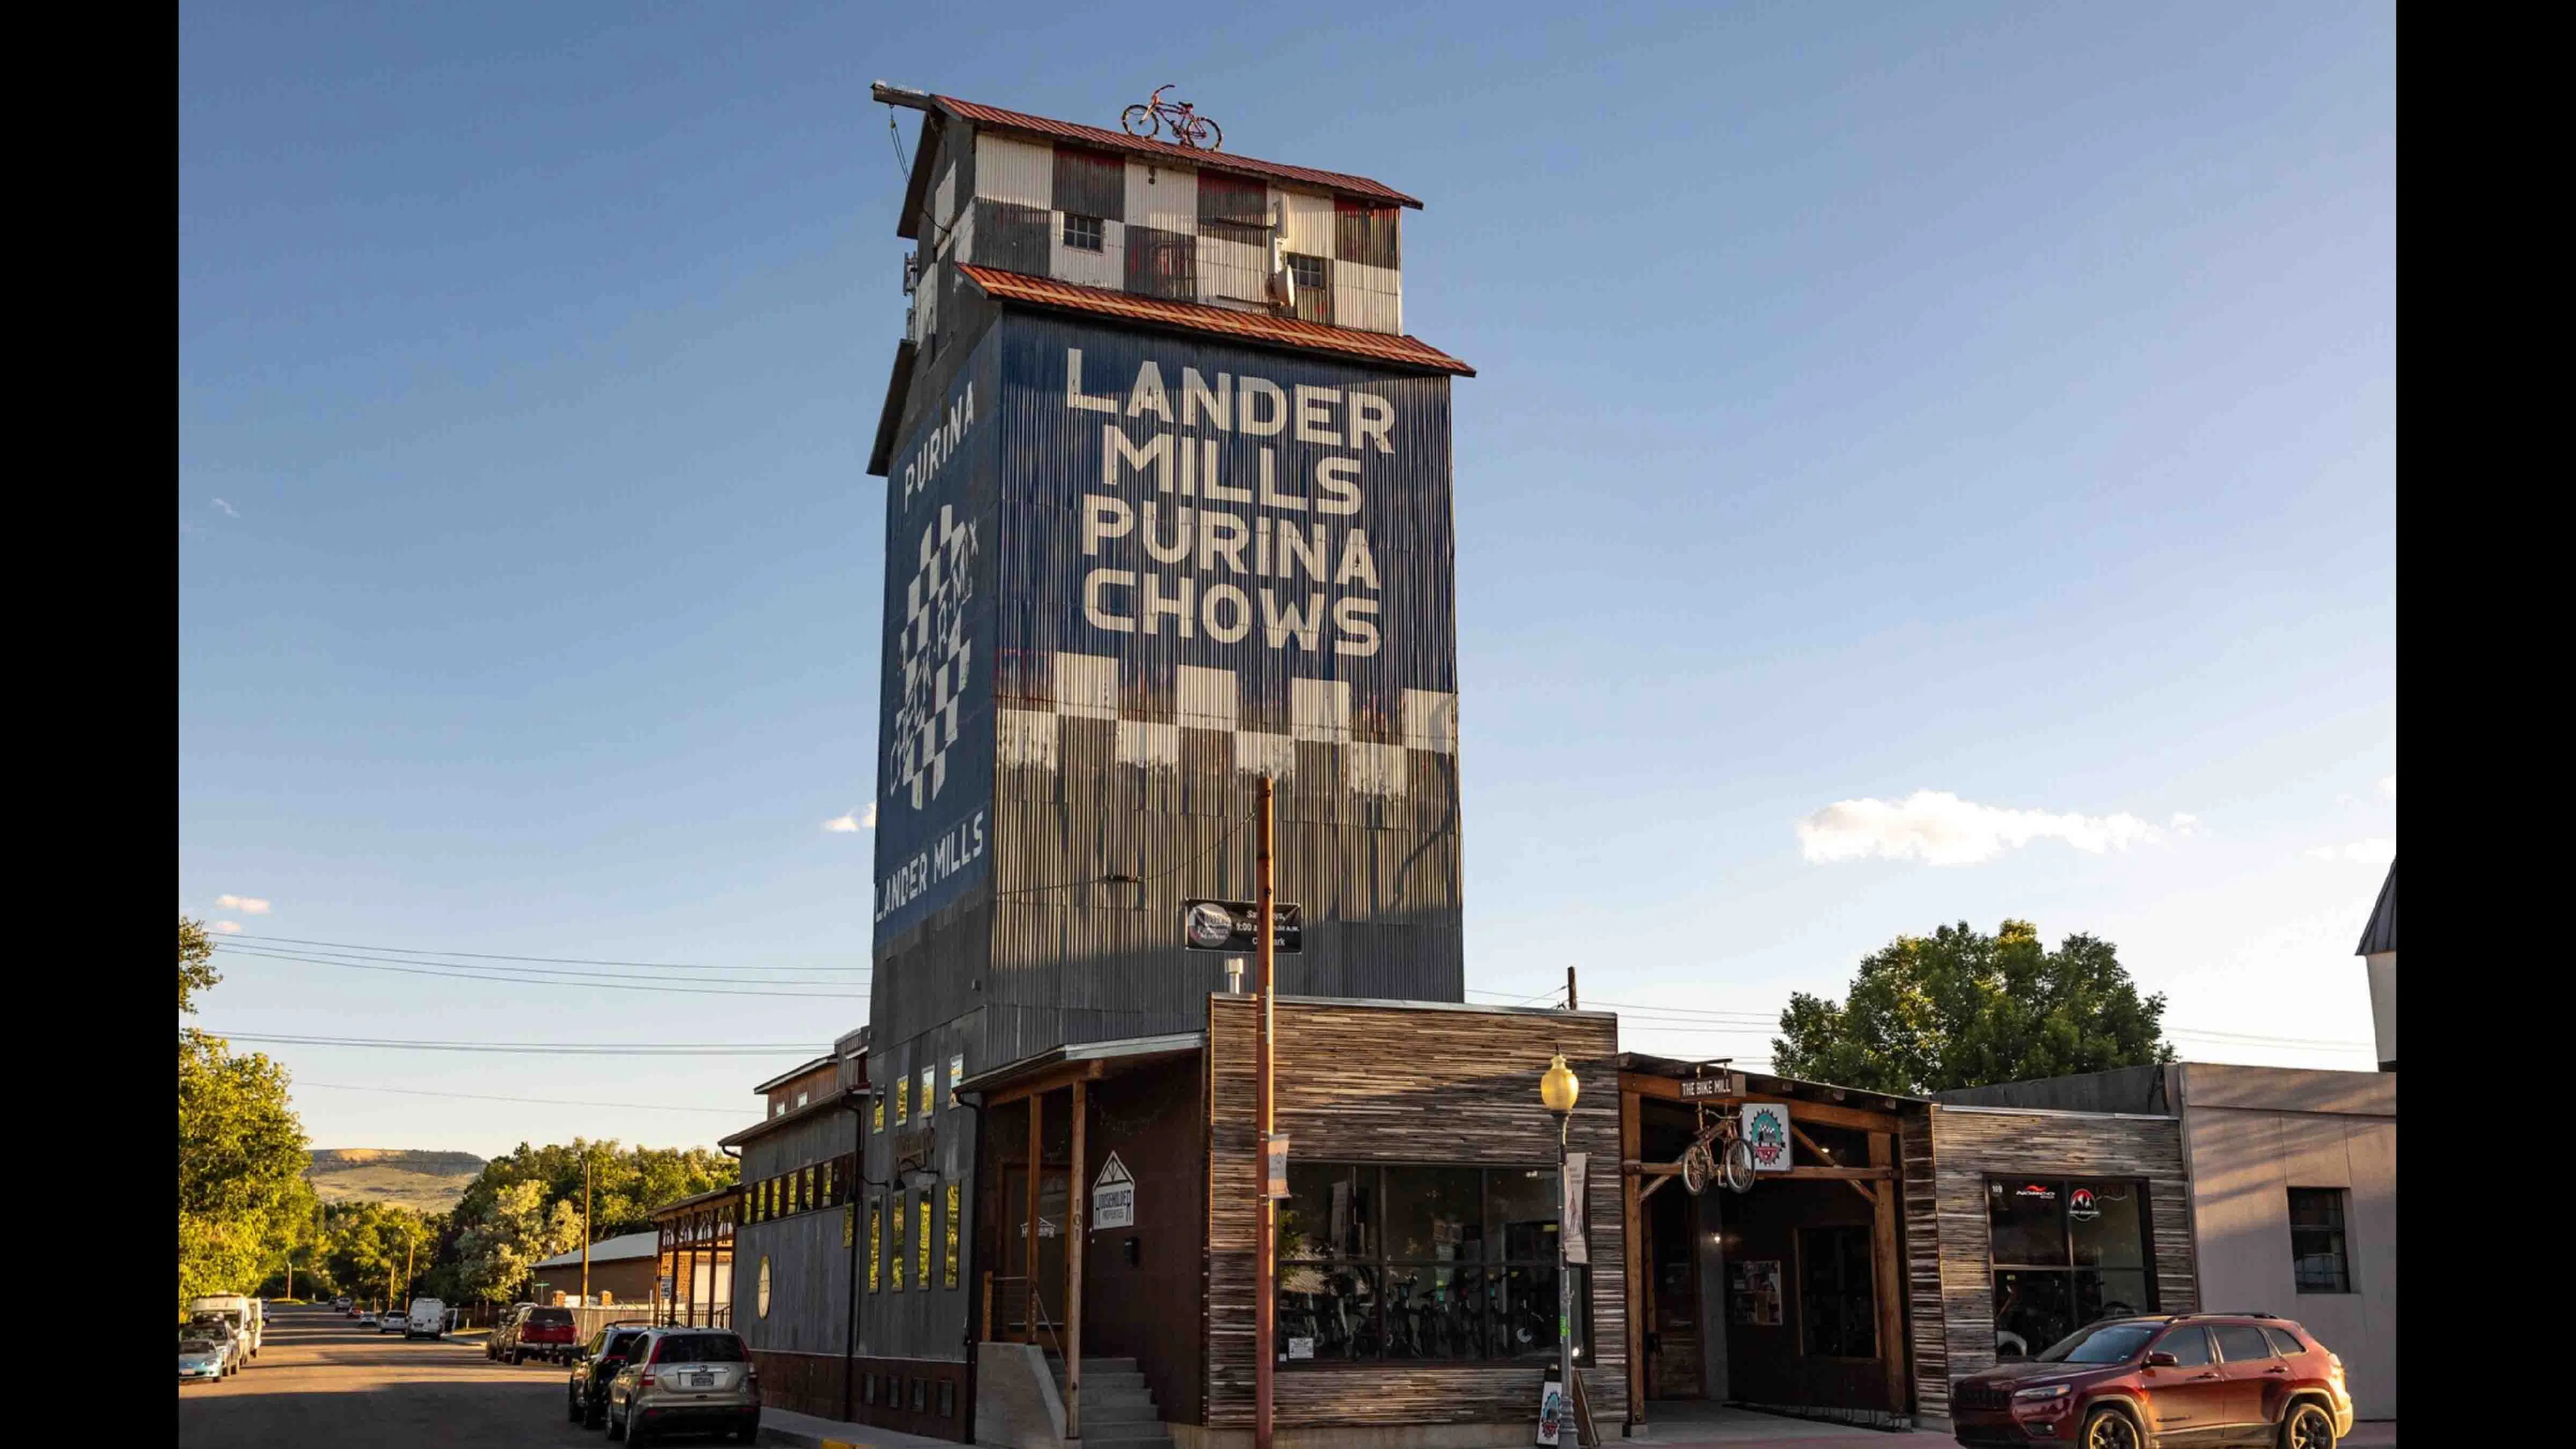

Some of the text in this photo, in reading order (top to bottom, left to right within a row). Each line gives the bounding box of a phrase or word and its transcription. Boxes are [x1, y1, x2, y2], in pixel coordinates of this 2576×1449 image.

[904, 380, 975, 514] PURINA
[1066, 347, 1396, 454] LANDER
[1102, 425, 1362, 516] MILLS
[1082, 493, 1381, 590] PURINA
[1083, 567, 1382, 657] CHOWS
[875, 810, 984, 924] LANDER MILLS
[1682, 1078, 1731, 1095] THE BIKE MILL
